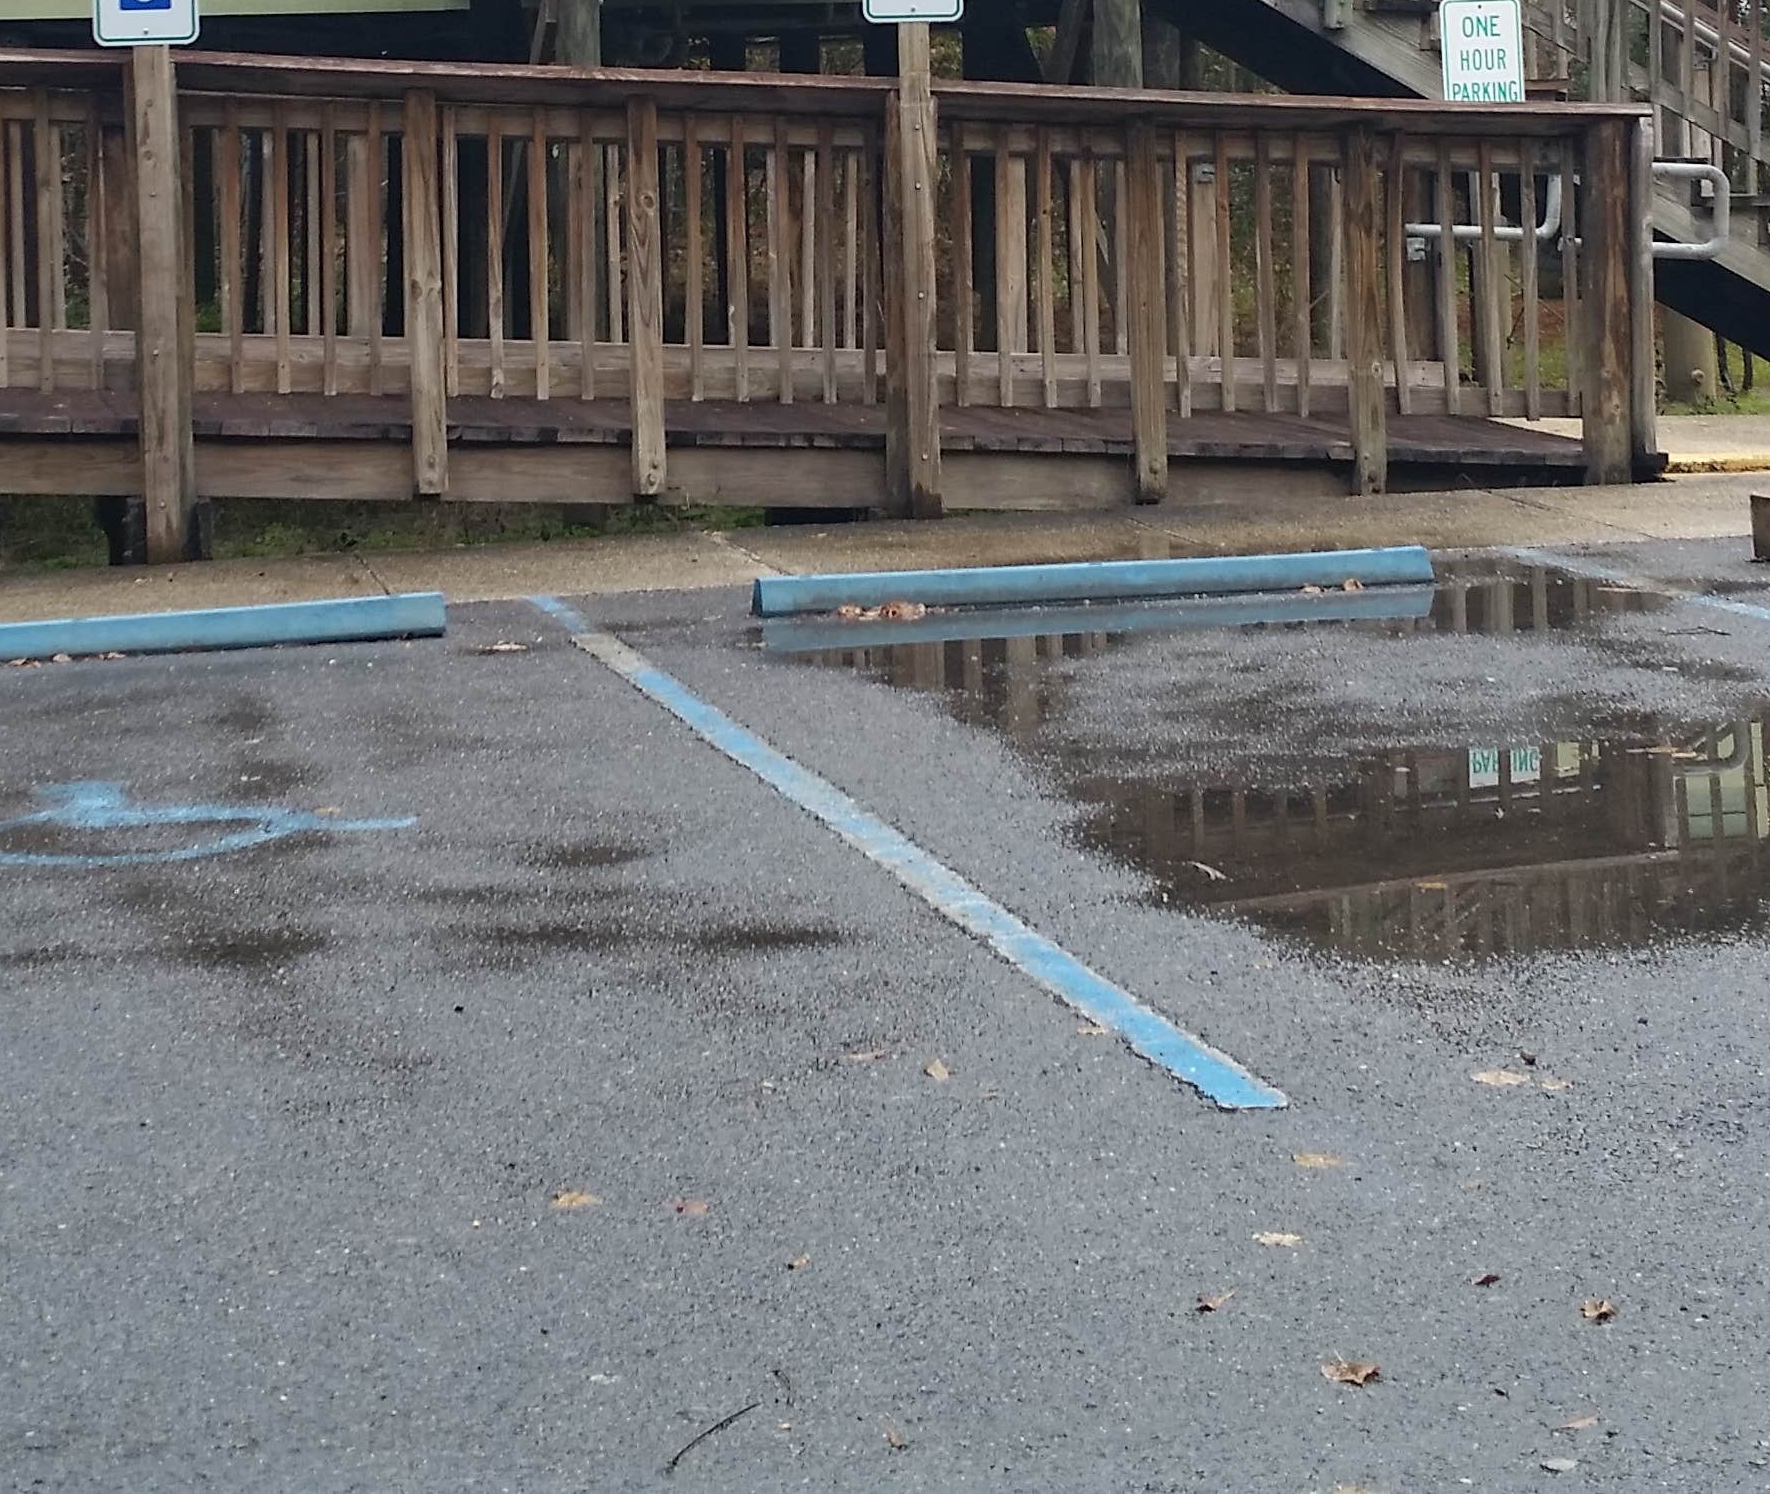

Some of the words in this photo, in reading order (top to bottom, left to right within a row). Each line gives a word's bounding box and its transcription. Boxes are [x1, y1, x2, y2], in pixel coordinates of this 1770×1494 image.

[1462, 15, 1501, 38] ONE
[1460, 48, 1507, 71] HOUR
[1452, 80, 1518, 102] PARKING
